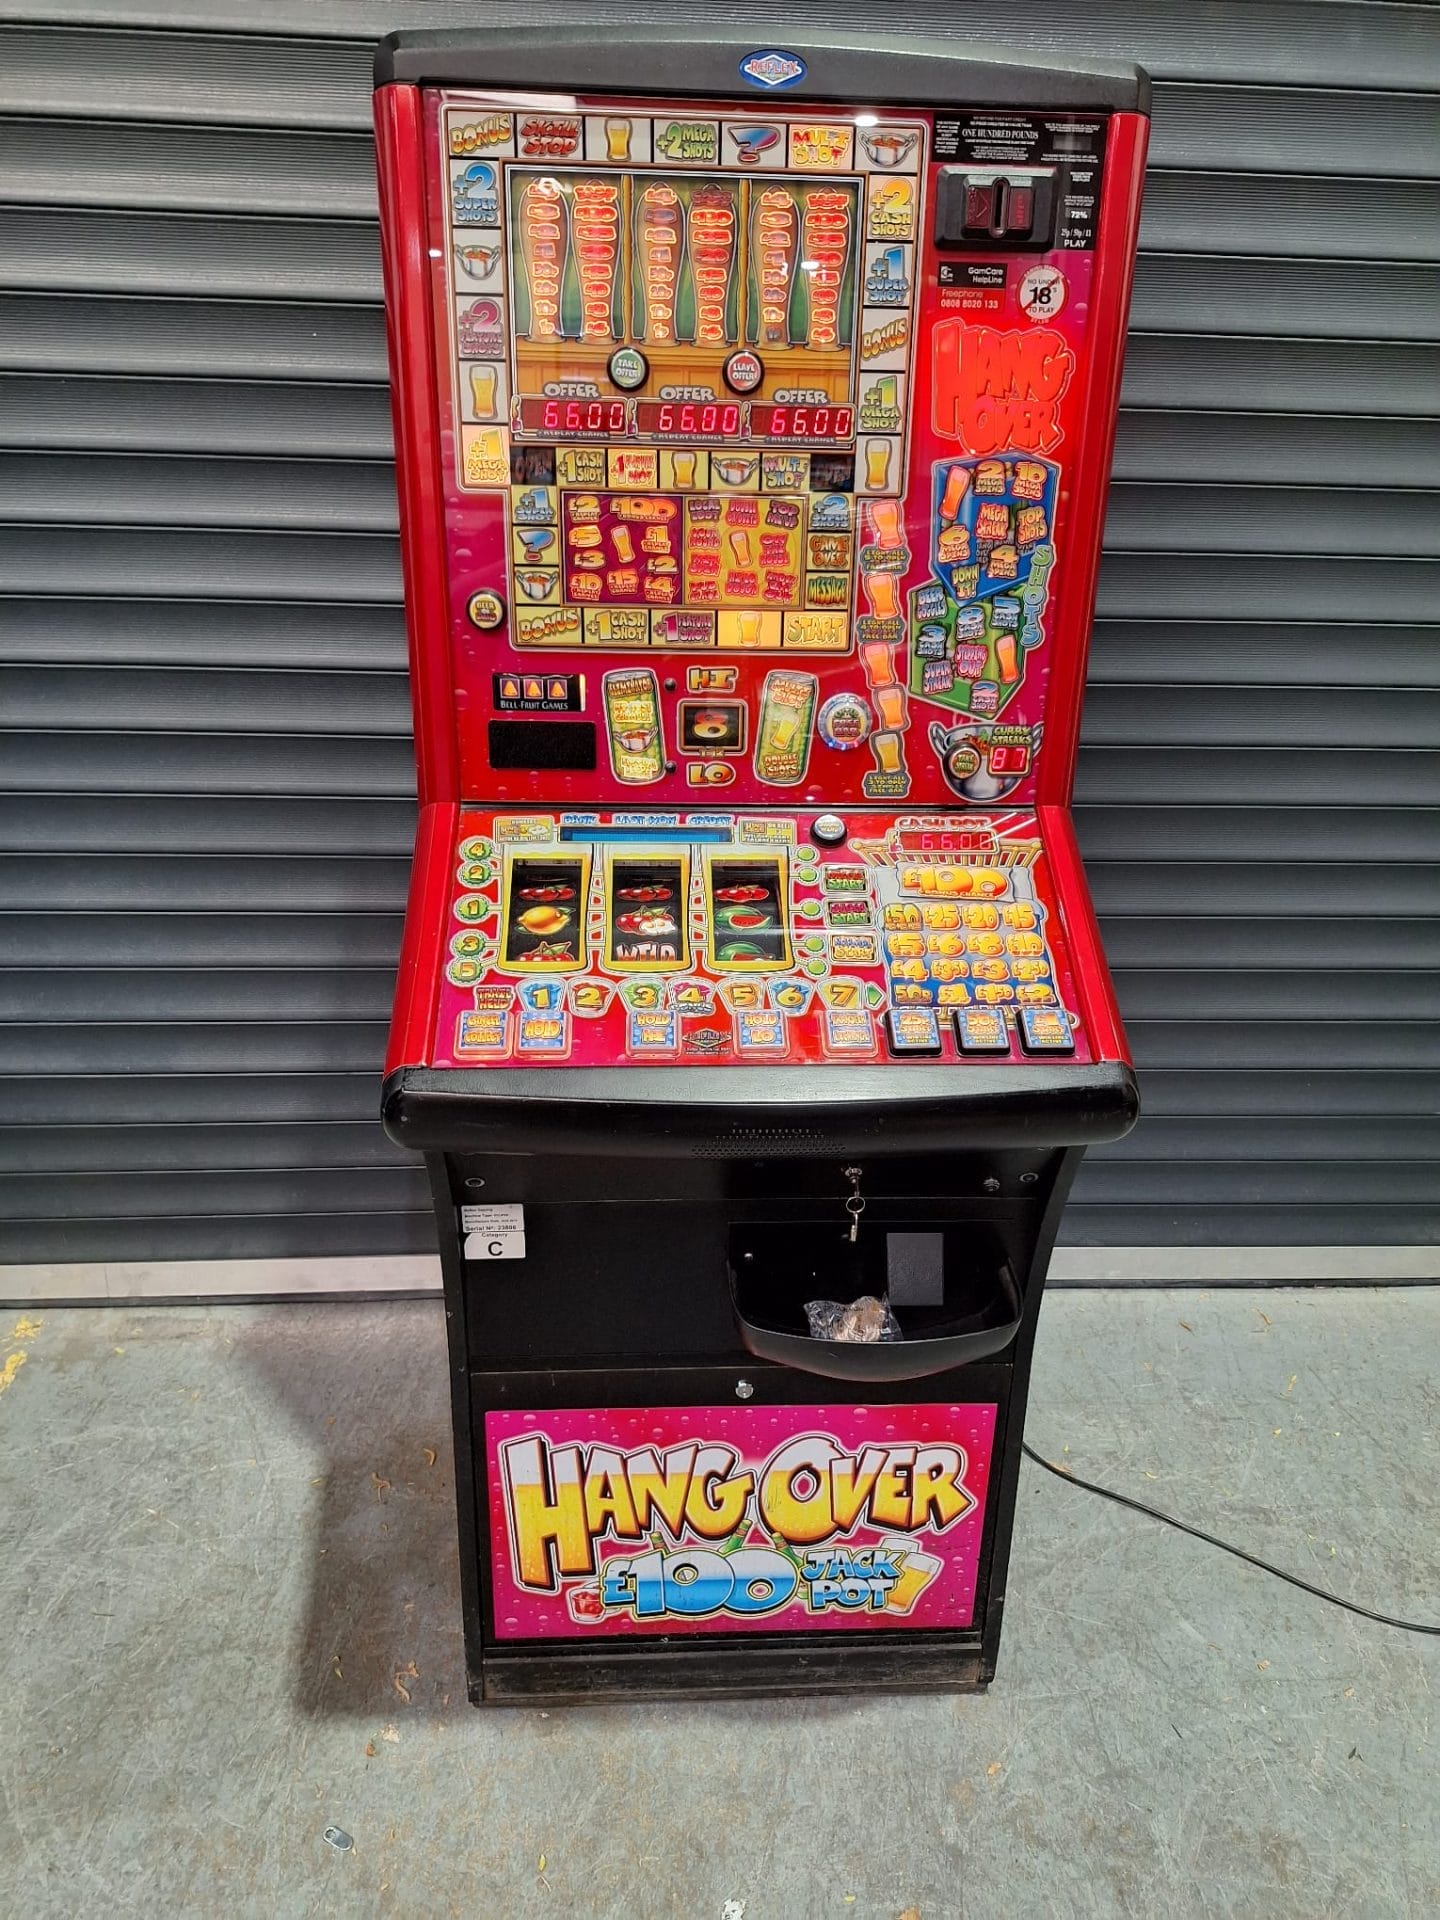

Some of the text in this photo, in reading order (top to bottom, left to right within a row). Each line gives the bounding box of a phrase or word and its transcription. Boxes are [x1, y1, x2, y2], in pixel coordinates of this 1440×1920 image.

[750, 60, 799, 75] REFLEX
[451, 115, 512, 153] BONUS
[522, 118, 581, 138] SKILL
[682, 124, 715, 143] MEGA
[962, 128, 1039, 140] ONE HUNDRED POUNDS
[523, 137, 577, 156] STOP
[657, 122, 683, 159] +2
[793, 127, 850, 148] MULTI
[681, 142, 714, 161] SHOTS
[793, 147, 843, 167] SHOT
[453, 162, 497, 199] +2
[454, 198, 498, 211] SUPER
[872, 178, 913, 214] +2
[456, 210, 497, 223] SHOTS
[871, 212, 911, 225] CASH
[1071, 210, 1088, 219] 72%
[872, 224, 910, 237] SHOTS
[1064, 239, 1087, 248] PLAY
[871, 246, 905, 279] +1
[968, 267, 1004, 276] GamCare
[867, 278, 909, 290] SUPER
[972, 276, 1003, 284] HelpLine
[870, 289, 905, 302] SHOT
[942, 289, 984, 299] Freephone
[941, 300, 999, 309] 0808 8020 133
[460, 299, 501, 333] +2
[863, 319, 906, 361] BONUS
[617, 358, 639, 368] TAKE
[732, 362, 756, 372] LEAVE
[615, 368, 640, 378] OFFER
[732, 371, 757, 381] OFFER
[933, 318, 1076, 440] HANG
[544, 383, 599, 398] OFFER
[660, 386, 716, 401] OFFER
[775, 389, 828, 404] OFFER
[865, 375, 898, 408] +1
[544, 402, 624, 430] 66.00
[861, 406, 900, 418] MEGA
[771, 408, 850, 436] 66.00
[862, 417, 898, 430] SHOT
[960, 395, 1064, 456] OVER
[470, 429, 504, 460] +1
[467, 459, 507, 472] MEGA
[559, 450, 577, 482] +1
[576, 452, 602, 467] CASH
[764, 456, 808, 472] MULTI
[470, 470, 507, 483] SHOT
[576, 467, 602, 483] SHOT
[766, 471, 805, 487] SHOT
[976, 461, 1004, 479] 2
[1016, 462, 1047, 482] 10
[976, 478, 1004, 486] MEGA
[519, 487, 549, 508] +1
[569, 496, 600, 512] £2
[610, 497, 677, 516] £100
[813, 495, 848, 515] +2
[770, 501, 799, 516] TOP
[980, 504, 1008, 521] MEGA
[1017, 508, 1043, 526] TOP
[1018, 524, 1046, 543] SHOTS
[648, 556, 678, 573] £2
[953, 565, 979, 583] DOWN
[1021, 544, 1053, 646] SHOTS
[519, 608, 579, 642] BONUS
[587, 610, 611, 640] +1
[611, 611, 645, 627] CASH
[653, 611, 679, 641] +1
[611, 626, 645, 642] SHOT
[678, 627, 710, 642] SHOT
[785, 614, 845, 644] START
[959, 660, 982, 677] OUT
[690, 668, 735, 690] HI
[541, 701, 569, 711] GAMES
[991, 735, 1033, 745] STREAKS
[994, 726, 1032, 736] CURRY
[689, 765, 734, 784] LO
[899, 817, 988, 829] CASH POT
[468, 842, 486, 857] 4
[469, 865, 483, 879] 2
[904, 866, 1008, 893] £100
[828, 878, 864, 890] START
[467, 900, 479, 915] 1
[884, 903, 922, 924] £50
[924, 903, 960, 930] £25
[963, 903, 999, 930] £20
[1002, 903, 1036, 930] £15
[832, 912, 867, 923] START
[463, 936, 480, 951] 3
[834, 946, 872, 958] START
[887, 933, 925, 956] £5
[927, 933, 965, 956] £6
[967, 932, 1004, 956] £8
[1006, 933, 1044, 954] £10
[459, 963, 476, 977] 5
[891, 959, 928, 981] £4
[972, 959, 1009, 981] £3
[533, 987, 550, 1009] 1
[576, 988, 604, 1008] 2
[634, 986, 659, 1007] 3
[678, 986, 701, 1003] 4
[730, 985, 756, 1005] 5
[776, 986, 804, 1006] 6
[829, 985, 857, 1006] 7
[637, 1014, 670, 1026] HOLD
[745, 1013, 777, 1025] HOLD
[525, 1020, 561, 1039] HOLD
[751, 1030, 775, 1043] LO
[487, 1241, 504, 1257] C
[503, 1434, 975, 1590] HANG OVER
[801, 1548, 905, 1580] JACK
[602, 1548, 799, 1618] £100
[814, 1577, 895, 1610] POT
